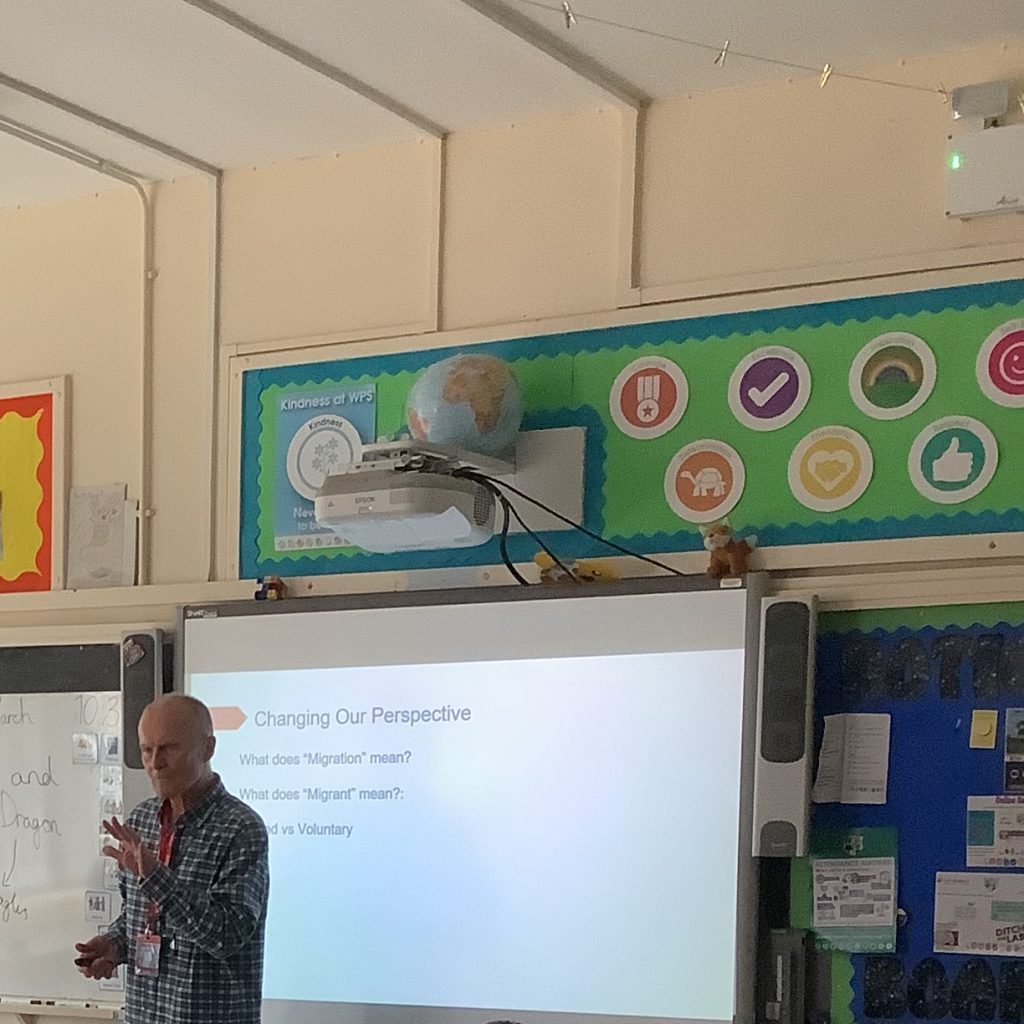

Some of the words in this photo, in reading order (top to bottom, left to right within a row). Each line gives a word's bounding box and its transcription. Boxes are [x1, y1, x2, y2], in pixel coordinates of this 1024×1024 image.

[281, 396, 330, 410] Kindness
[333, 394, 346, 405] at
[349, 390, 374, 403] WPS
[308, 418, 344, 431] Kindness
[254, 708, 331, 730] Changing
[335, 707, 367, 725] Our
[372, 704, 472, 727] Perspective
[239, 753, 269, 766] What
[272, 753, 300, 765] does
[303, 751, 367, 767] “Migration”
[370, 750, 412, 764] mean?
[10, 756, 59, 787] and
[239, 788, 269, 801] What
[272, 788, 300, 800] does
[303, 787, 356, 803] “Migrant”
[359, 786, 404, 800] mean?:
[1, 790, 63, 850] Dragon
[281, 825, 294, 835] vs
[297, 823, 354, 838] Voluntary
